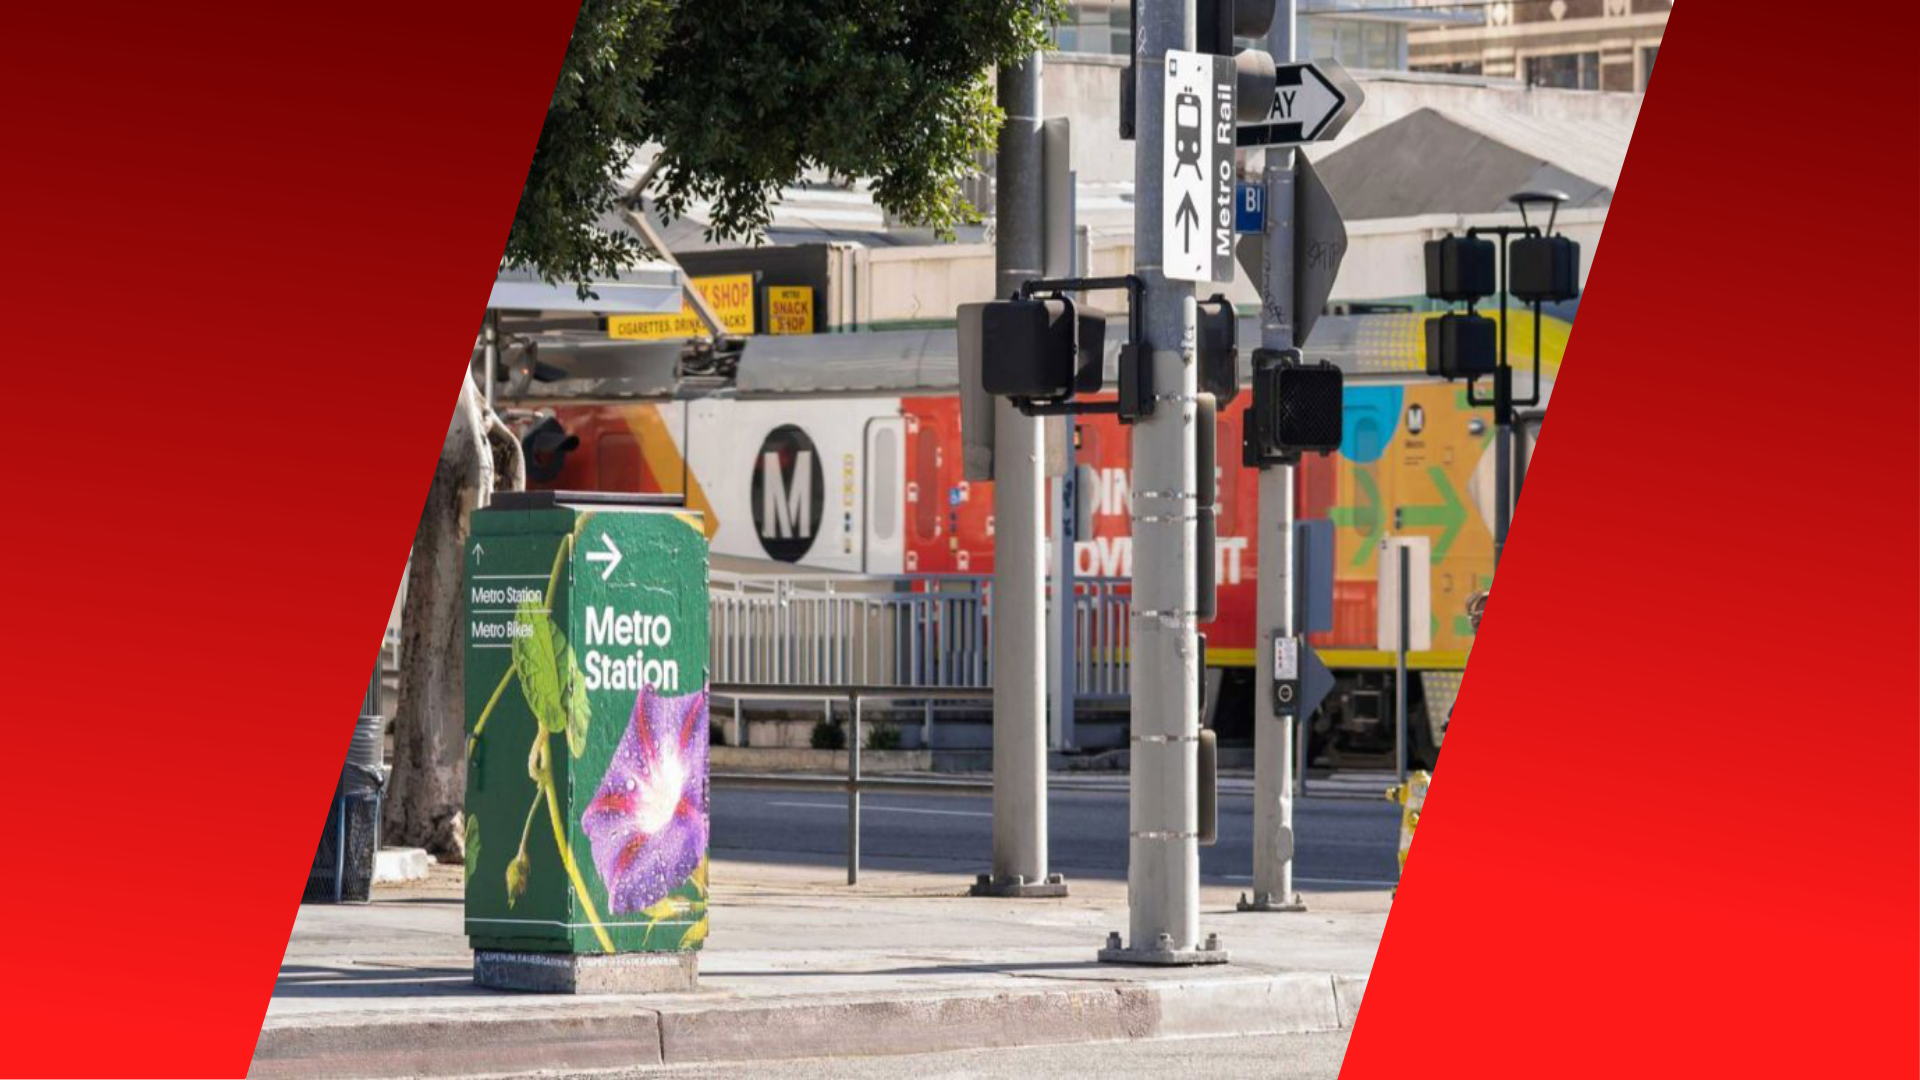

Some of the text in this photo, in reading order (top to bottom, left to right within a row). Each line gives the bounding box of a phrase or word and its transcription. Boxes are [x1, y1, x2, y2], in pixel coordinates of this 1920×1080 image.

[1270, 91, 1297, 119] AY
[1216, 84, 1231, 256] Metro Rail
[713, 283, 749, 309] SHOP
[773, 301, 809, 315] SNACK
[763, 451, 812, 538] M
[472, 586, 542, 604] Metro Station
[472, 621, 534, 638] Metro Bikes
[585, 606, 671, 647] Metro
[585, 649, 679, 691] Station
